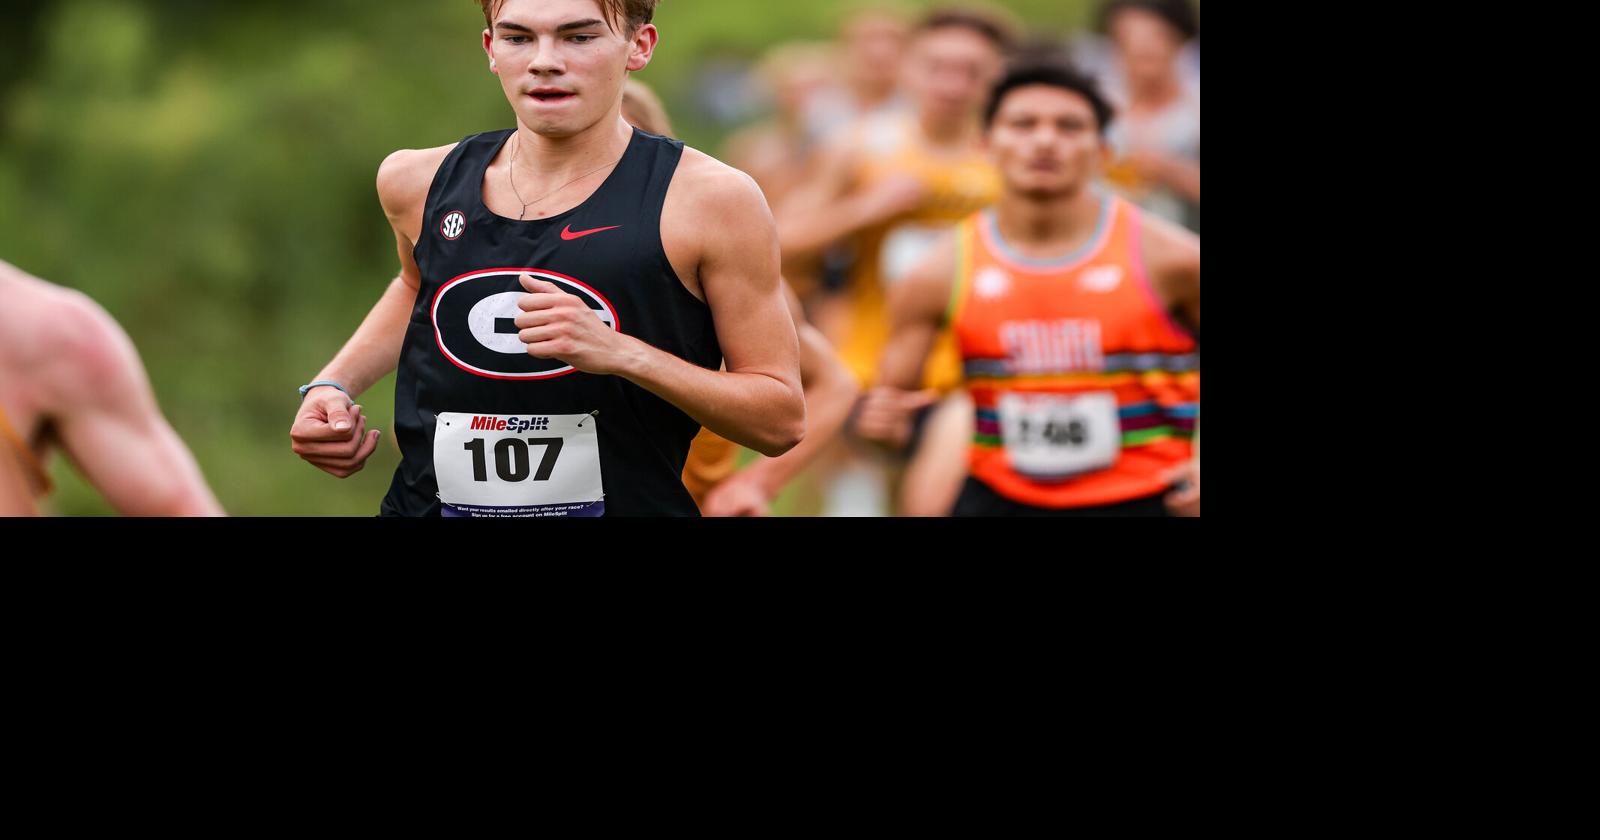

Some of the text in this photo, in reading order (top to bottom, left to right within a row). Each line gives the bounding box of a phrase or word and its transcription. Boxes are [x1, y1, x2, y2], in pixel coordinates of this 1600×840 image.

[442, 212, 464, 238] SEC
[470, 415, 550, 434] MileSplit
[464, 437, 564, 482] 107
